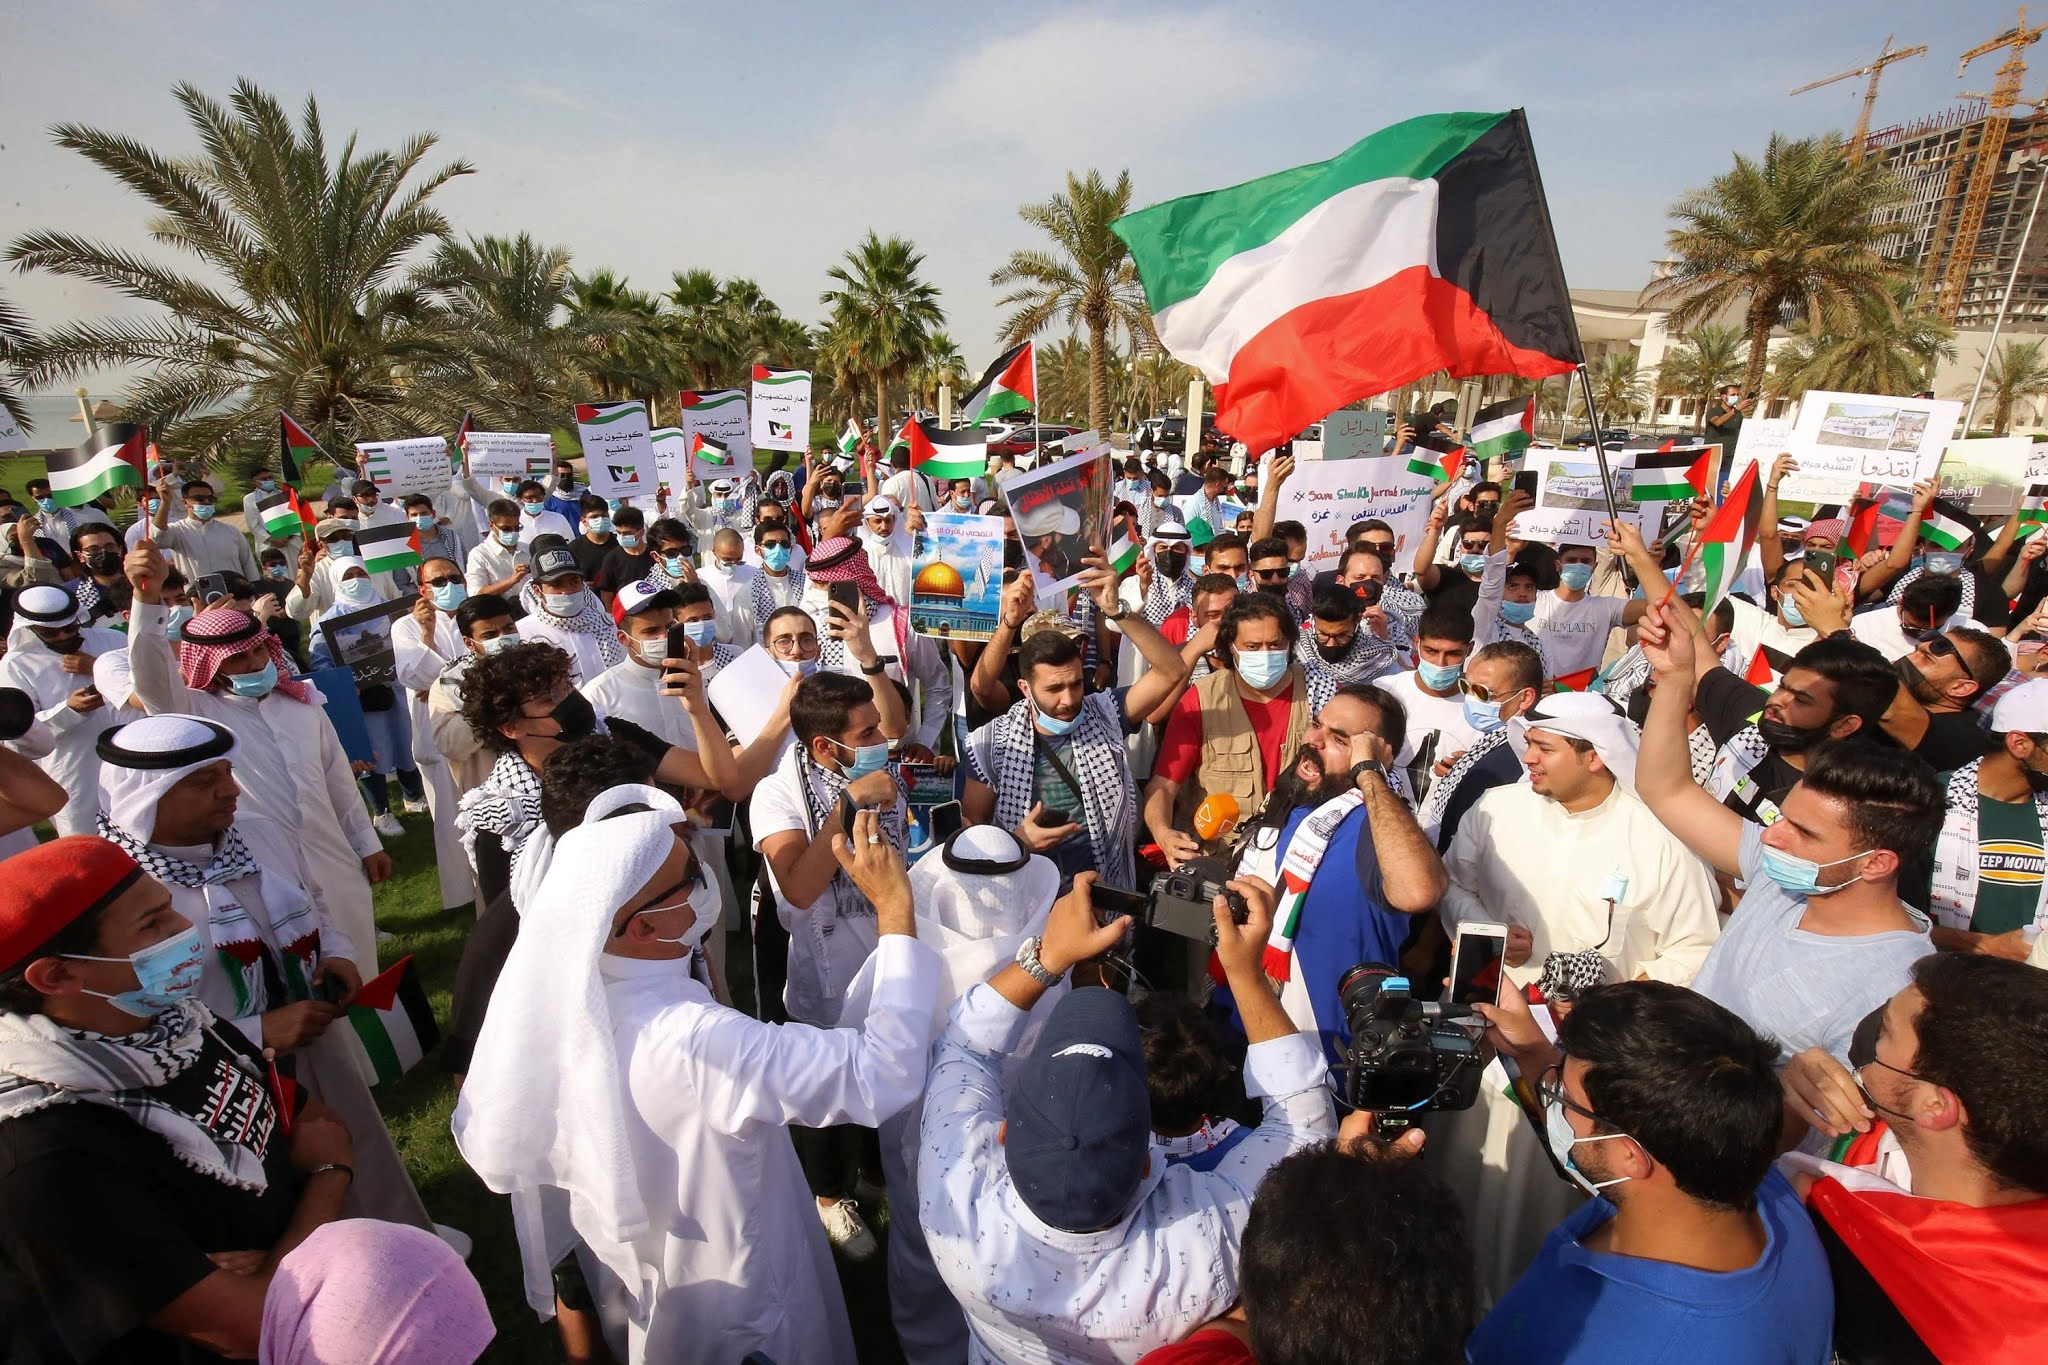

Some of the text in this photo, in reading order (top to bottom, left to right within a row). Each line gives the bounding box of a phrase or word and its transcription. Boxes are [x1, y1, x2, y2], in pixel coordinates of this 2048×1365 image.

[692, 418, 742, 427] القدس عاصمة
[1340, 420, 1380, 437] إسرائيل
[604, 430, 644, 442] كويتيون
[718, 429, 746, 439] فلسطين
[604, 444, 632, 457] التطبيع
[1836, 454, 1854, 462] حي
[1800, 461, 1852, 472] الشيخ جراح
[1860, 454, 1922, 478] أنقذوا
[1563, 518, 1580, 526] حي
[1530, 524, 1579, 536] الشيخ جراح
[1537, 618, 1595, 632] BALMAIN
[1979, 855, 2045, 872] EEP MOVIN
